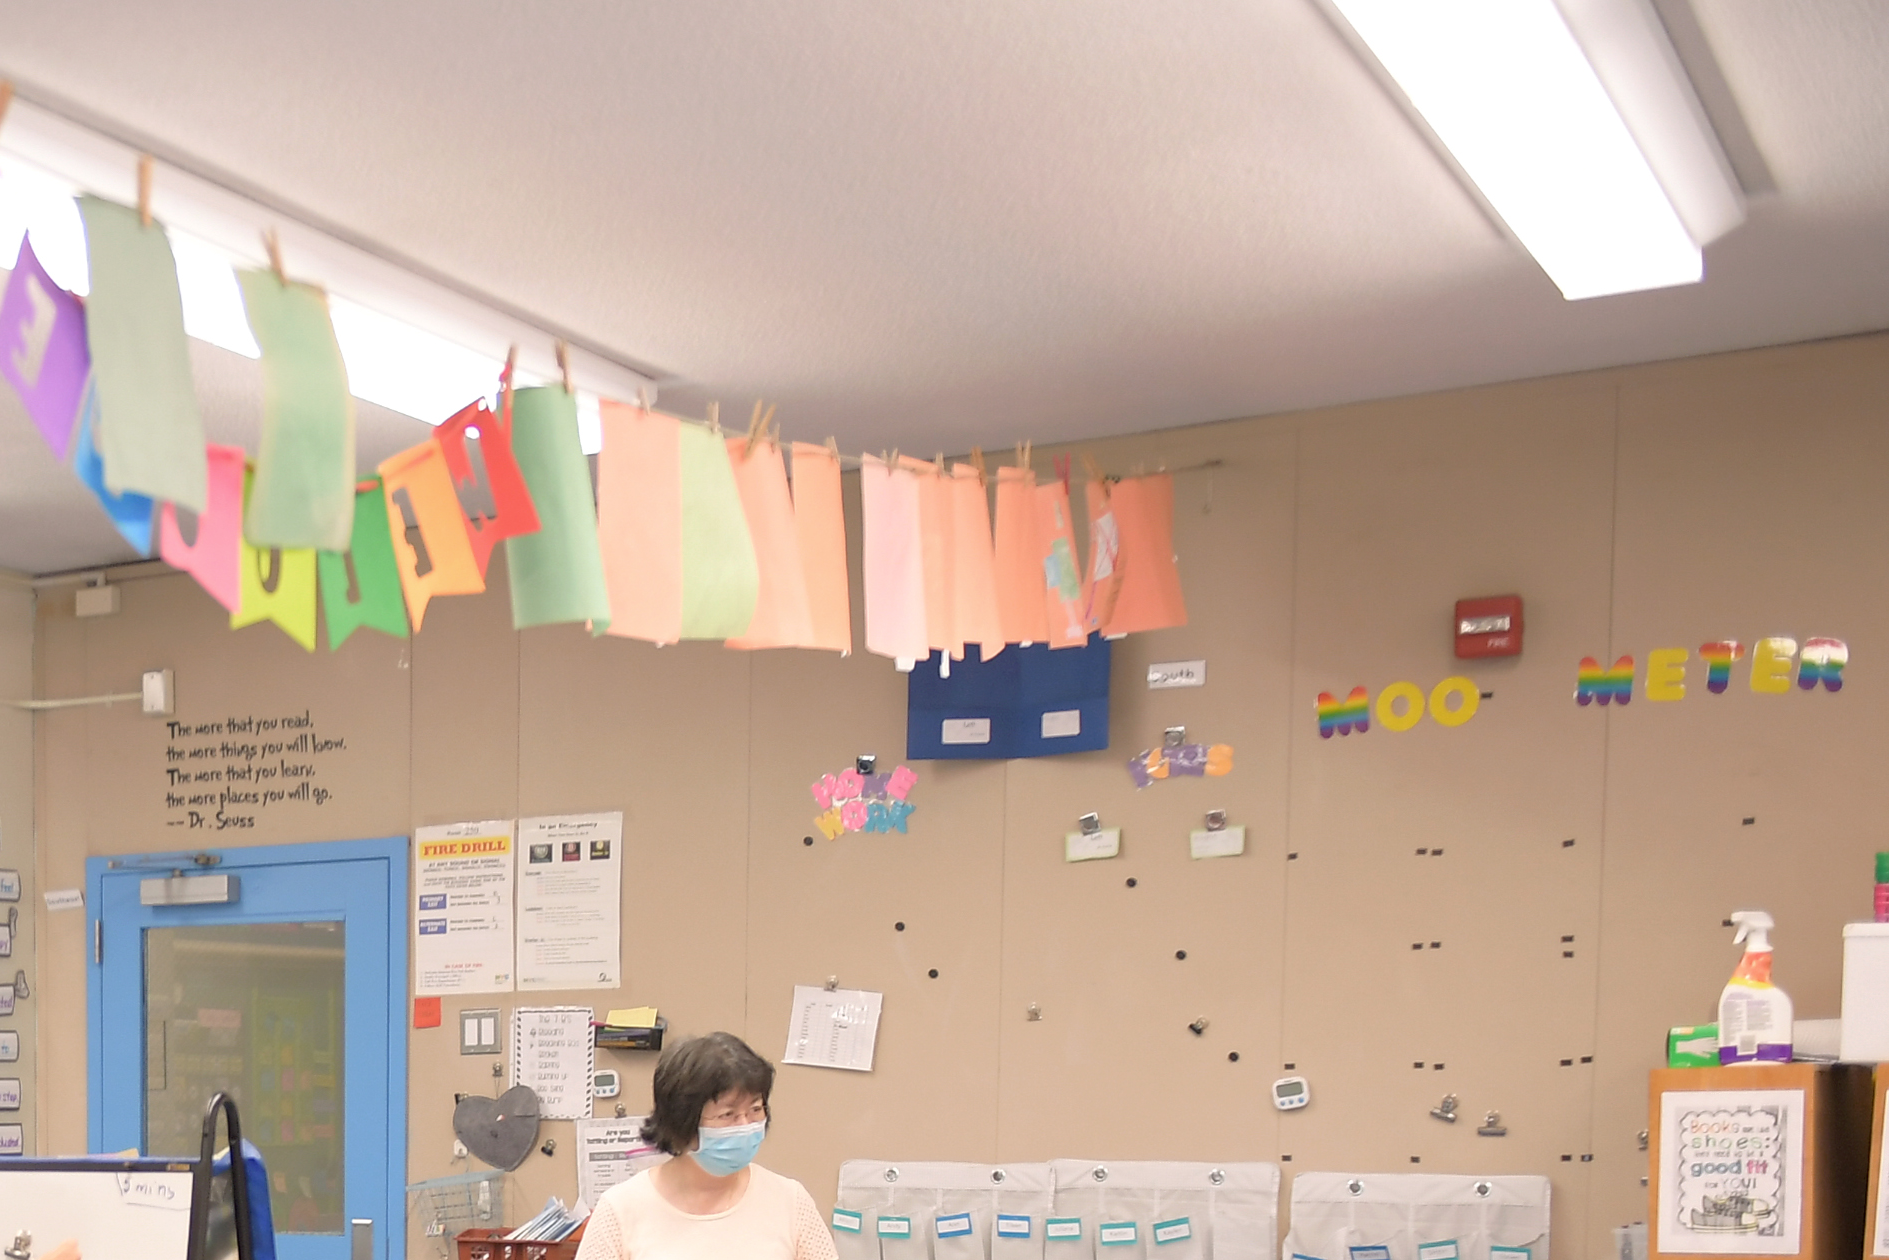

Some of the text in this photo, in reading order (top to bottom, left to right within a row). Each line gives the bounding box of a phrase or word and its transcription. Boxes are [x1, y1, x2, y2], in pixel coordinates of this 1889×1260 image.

[1574, 636, 1849, 707] METER
[167, 722, 192, 739] The
[195, 722, 223, 734] more
[227, 717, 254, 734] that
[256, 716, 278, 736] you
[167, 745, 185, 762] the
[189, 746, 216, 758] more
[220, 742, 257, 761] things
[261, 741, 283, 757] you
[286, 734, 308, 752] will
[167, 769, 191, 786] The
[194, 769, 222, 781] more
[226, 765, 252, 781] that
[255, 764, 277, 783] you
[167, 792, 185, 808] the
[188, 794, 216, 805] more
[220, 787, 258, 812] places
[263, 787, 285, 806] you
[289, 782, 310, 800] will
[812, 765, 919, 809] HOME
[216, 811, 255, 830] Seuss
[814, 800, 916, 841] WORK
[424, 841, 506, 856] FIRE DRILL
[1691, 1120, 1739, 1133] Books
[1692, 1135, 1770, 1149] shoes:
[1691, 1160, 1768, 1177] good fit
